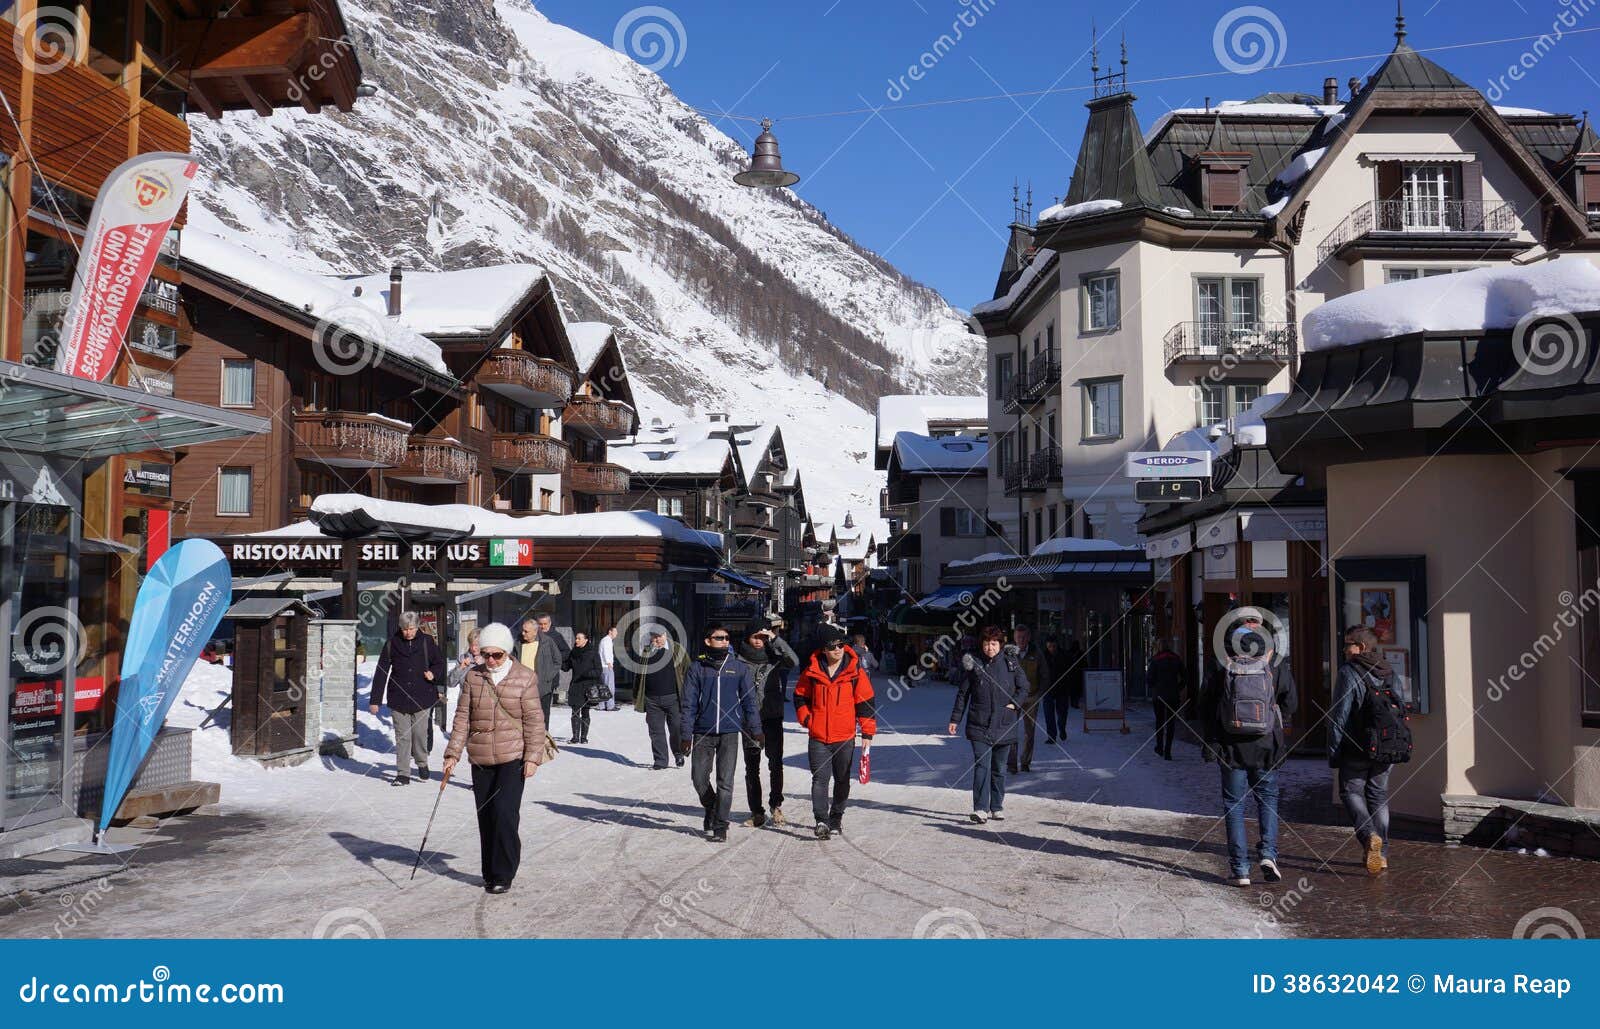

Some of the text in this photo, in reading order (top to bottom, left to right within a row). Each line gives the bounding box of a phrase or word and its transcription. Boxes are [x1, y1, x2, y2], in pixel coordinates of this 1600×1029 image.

[103, 230, 127, 261] UND
[1146, 457, 1188, 465] BERDOZ
[232, 544, 342, 561] RISTORANT
[361, 544, 480, 561] SEILRHAUS
[578, 584, 625, 595] swatch
[157, 581, 216, 682] MATTERHORN
